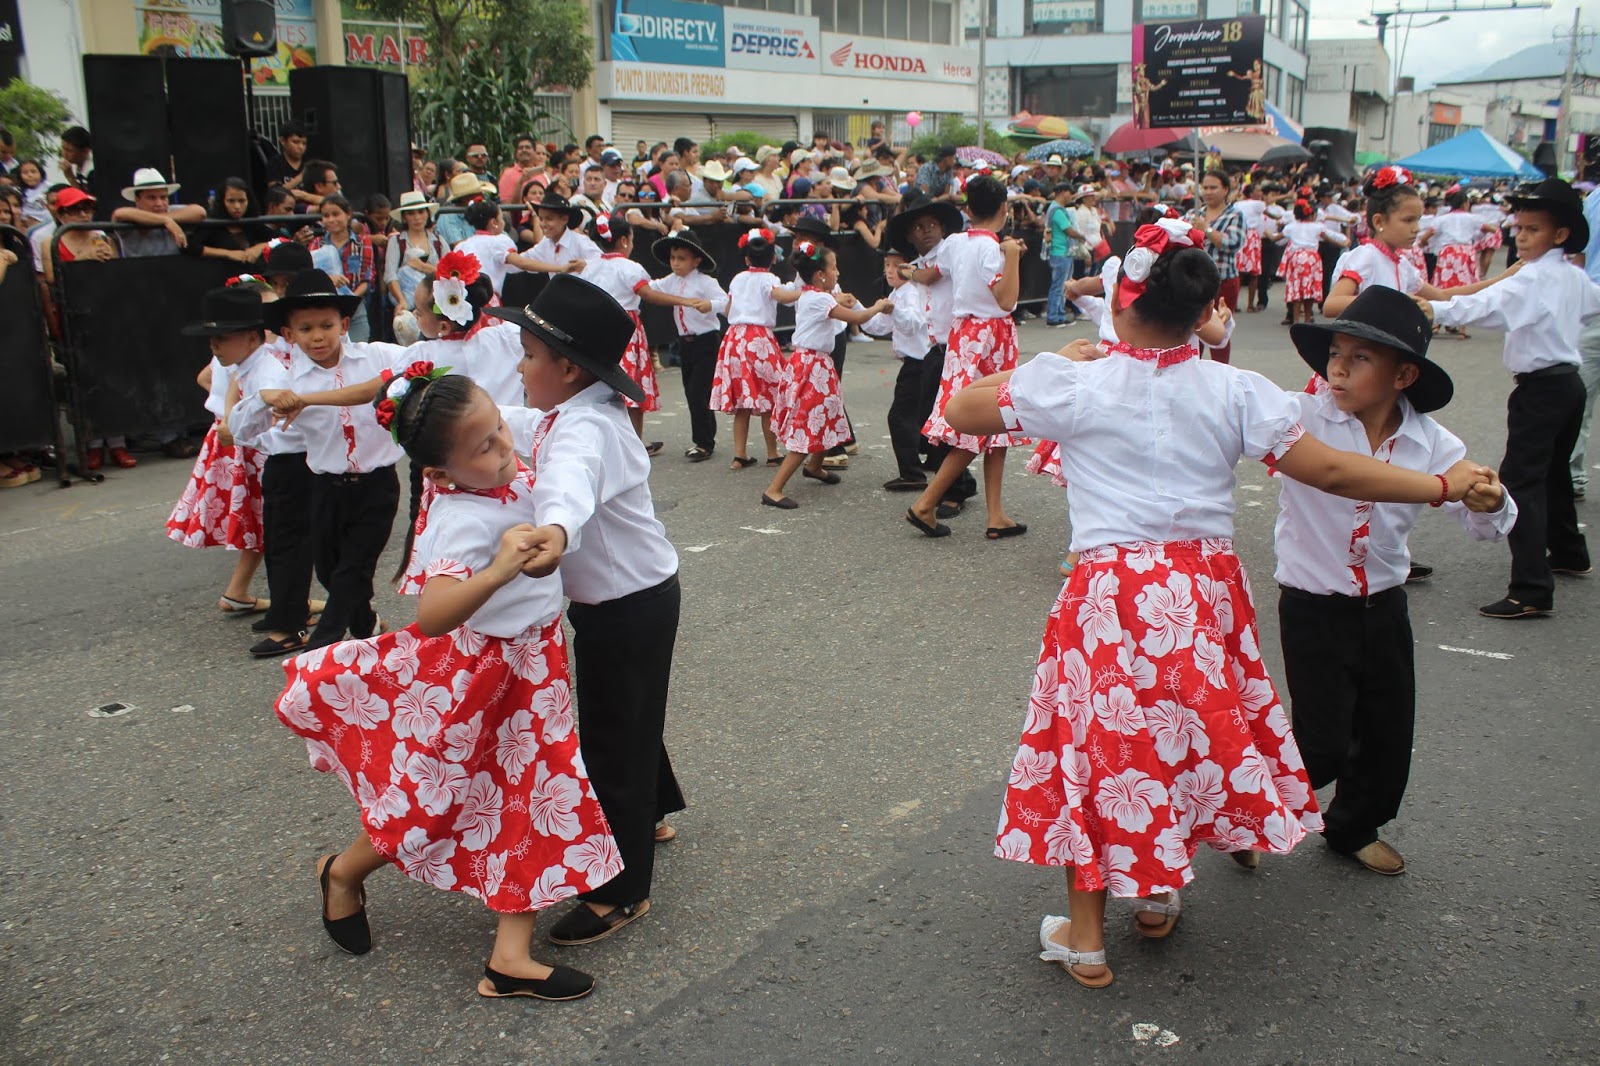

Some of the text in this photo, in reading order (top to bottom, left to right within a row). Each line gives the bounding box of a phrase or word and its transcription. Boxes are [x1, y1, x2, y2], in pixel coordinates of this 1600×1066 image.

[148, 12, 307, 44] FERTILTES
[643, 15, 716, 42] DIRECTV
[1222, 21, 1243, 42] 18
[731, 32, 815, 59] DEPRISA
[854, 52, 972, 78] HONDA Herca
[615, 68, 725, 96] PUNTO MAYORISTA PREPAGO
